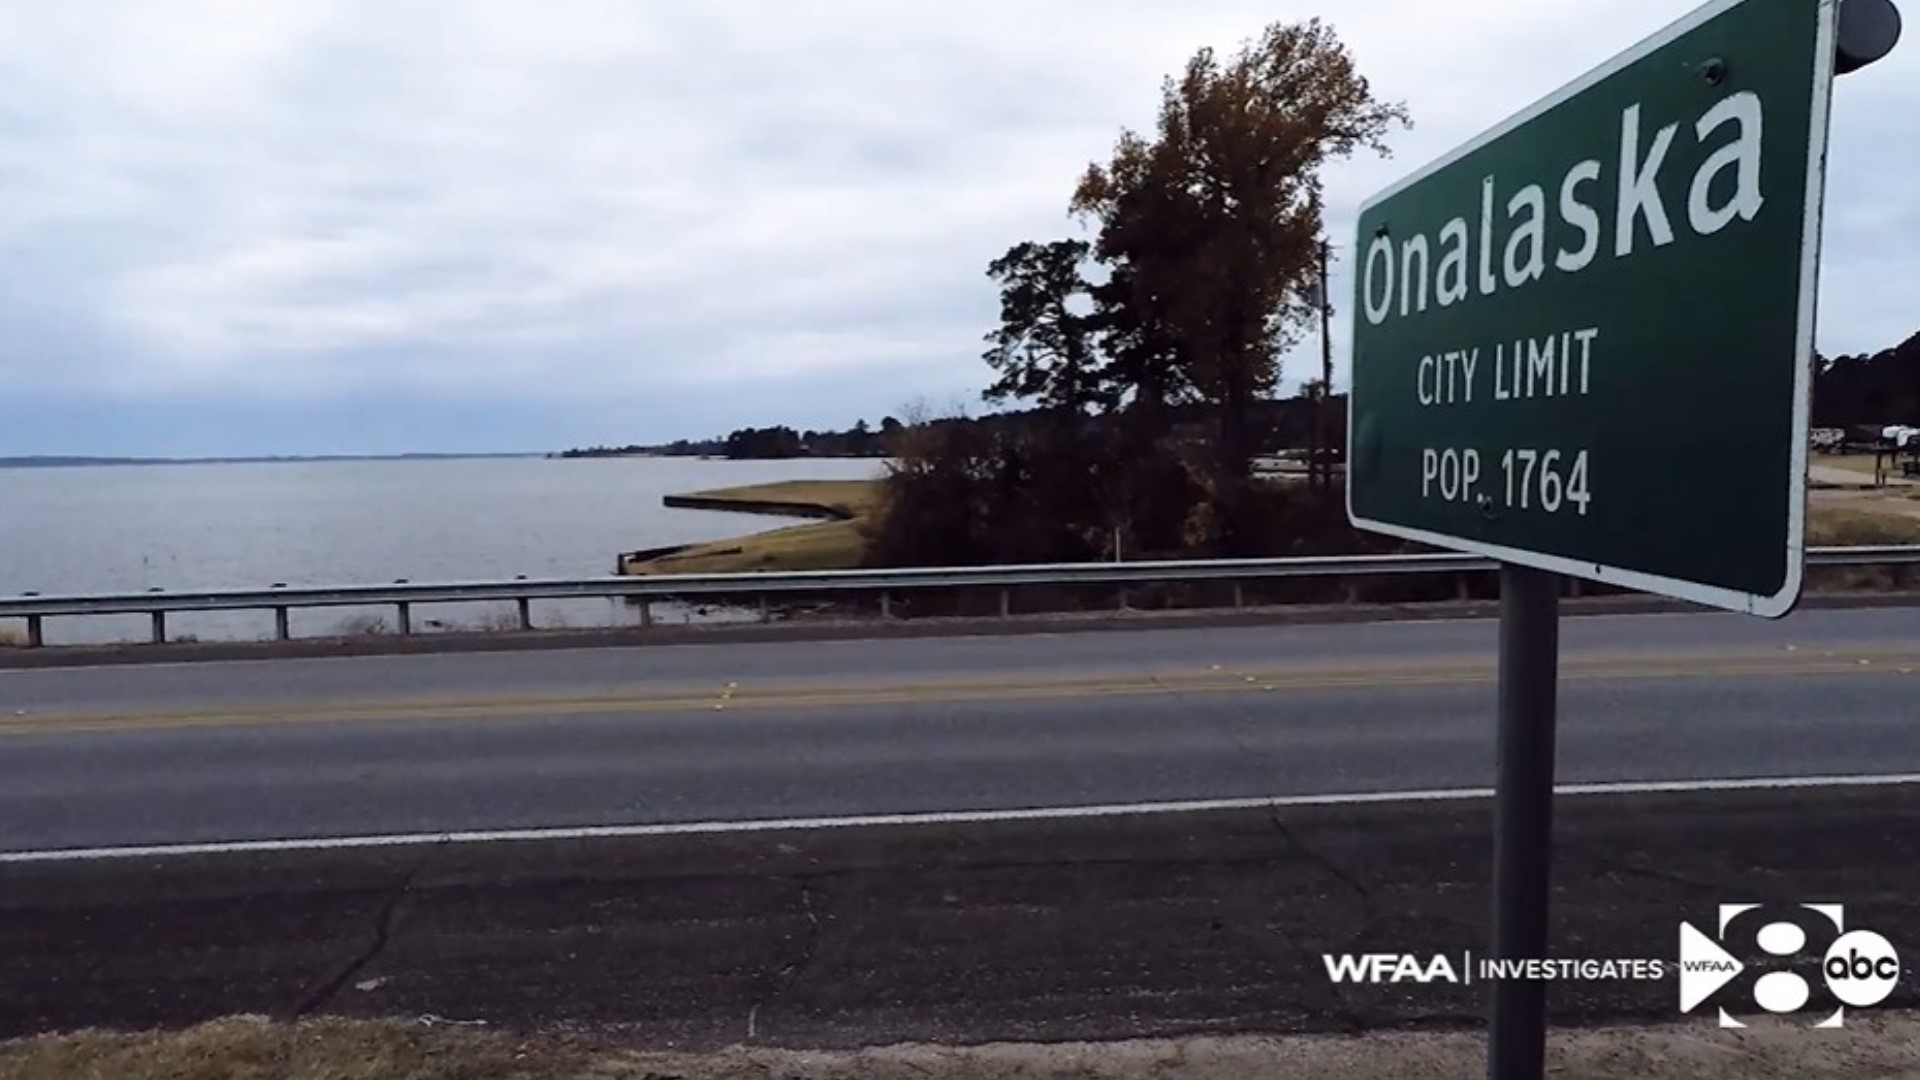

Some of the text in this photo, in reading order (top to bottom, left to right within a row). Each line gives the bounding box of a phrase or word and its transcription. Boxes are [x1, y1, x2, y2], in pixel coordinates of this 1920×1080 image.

[1363, 91, 1765, 325] Onalaska
[1418, 327, 1599, 405] CITY LIMIT
[1422, 448, 1591, 516] POP. 1764
